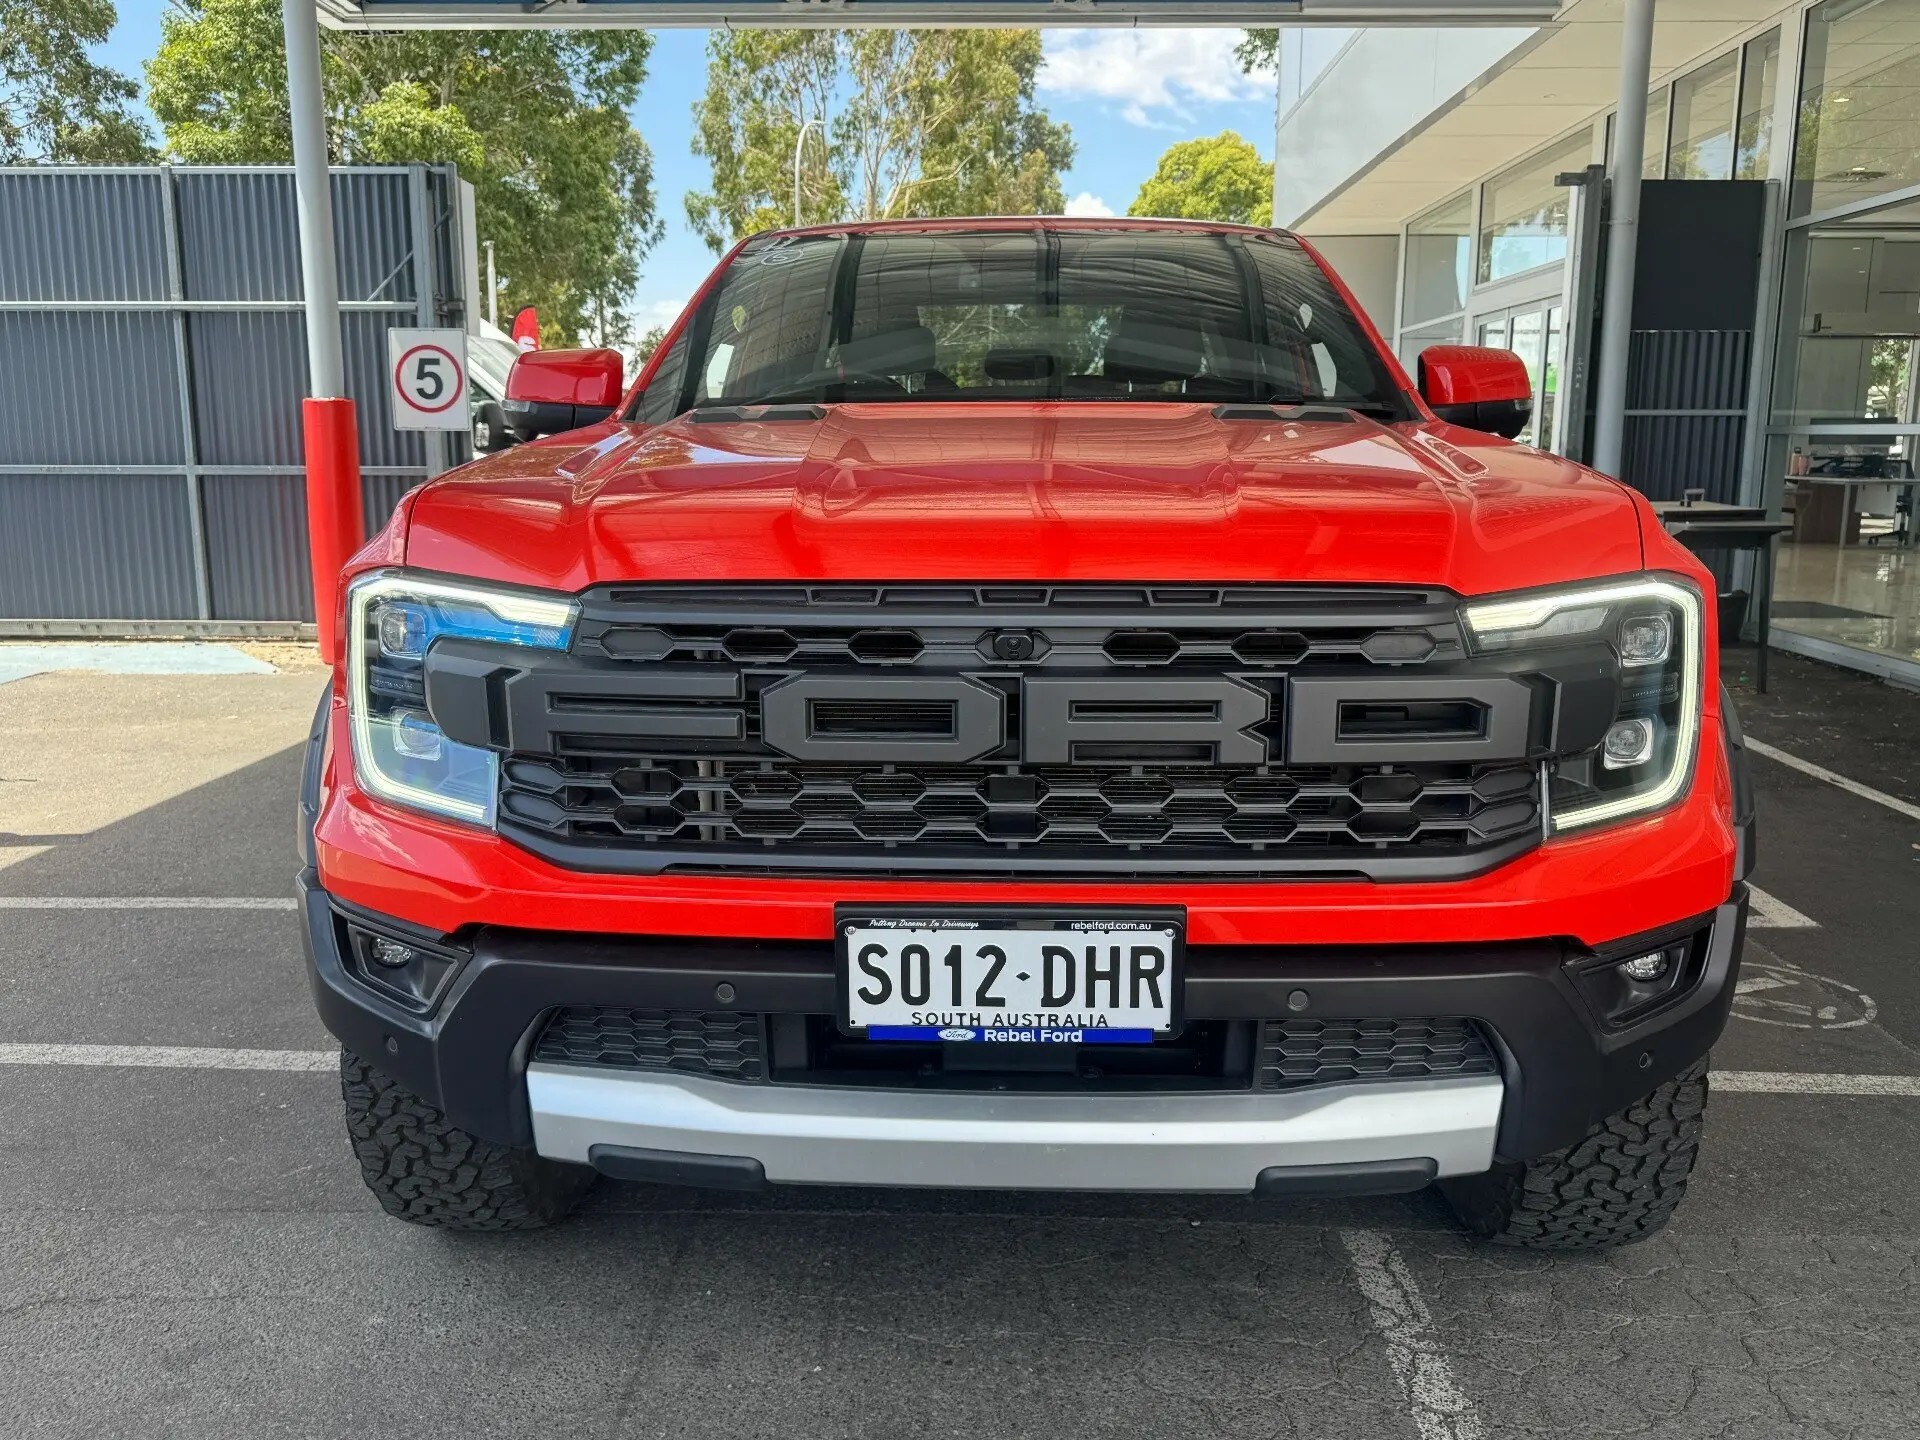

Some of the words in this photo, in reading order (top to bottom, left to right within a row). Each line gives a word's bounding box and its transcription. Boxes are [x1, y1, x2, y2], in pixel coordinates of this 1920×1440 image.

[416, 357, 444, 400] 5
[506, 670, 1534, 765] FORD
[868, 918, 897, 929] Putting
[898, 918, 927, 928] Dreams
[928, 919, 940, 928] In
[941, 919, 980, 930] Driveways
[1070, 920, 1152, 931] rebelford.com.au
[911, 1011, 982, 1027] SOUTH
[992, 1013, 1109, 1029] AUSTRALIA
[983, 1029, 1036, 1042] Rebel
[1040, 1029, 1084, 1043] Ford
